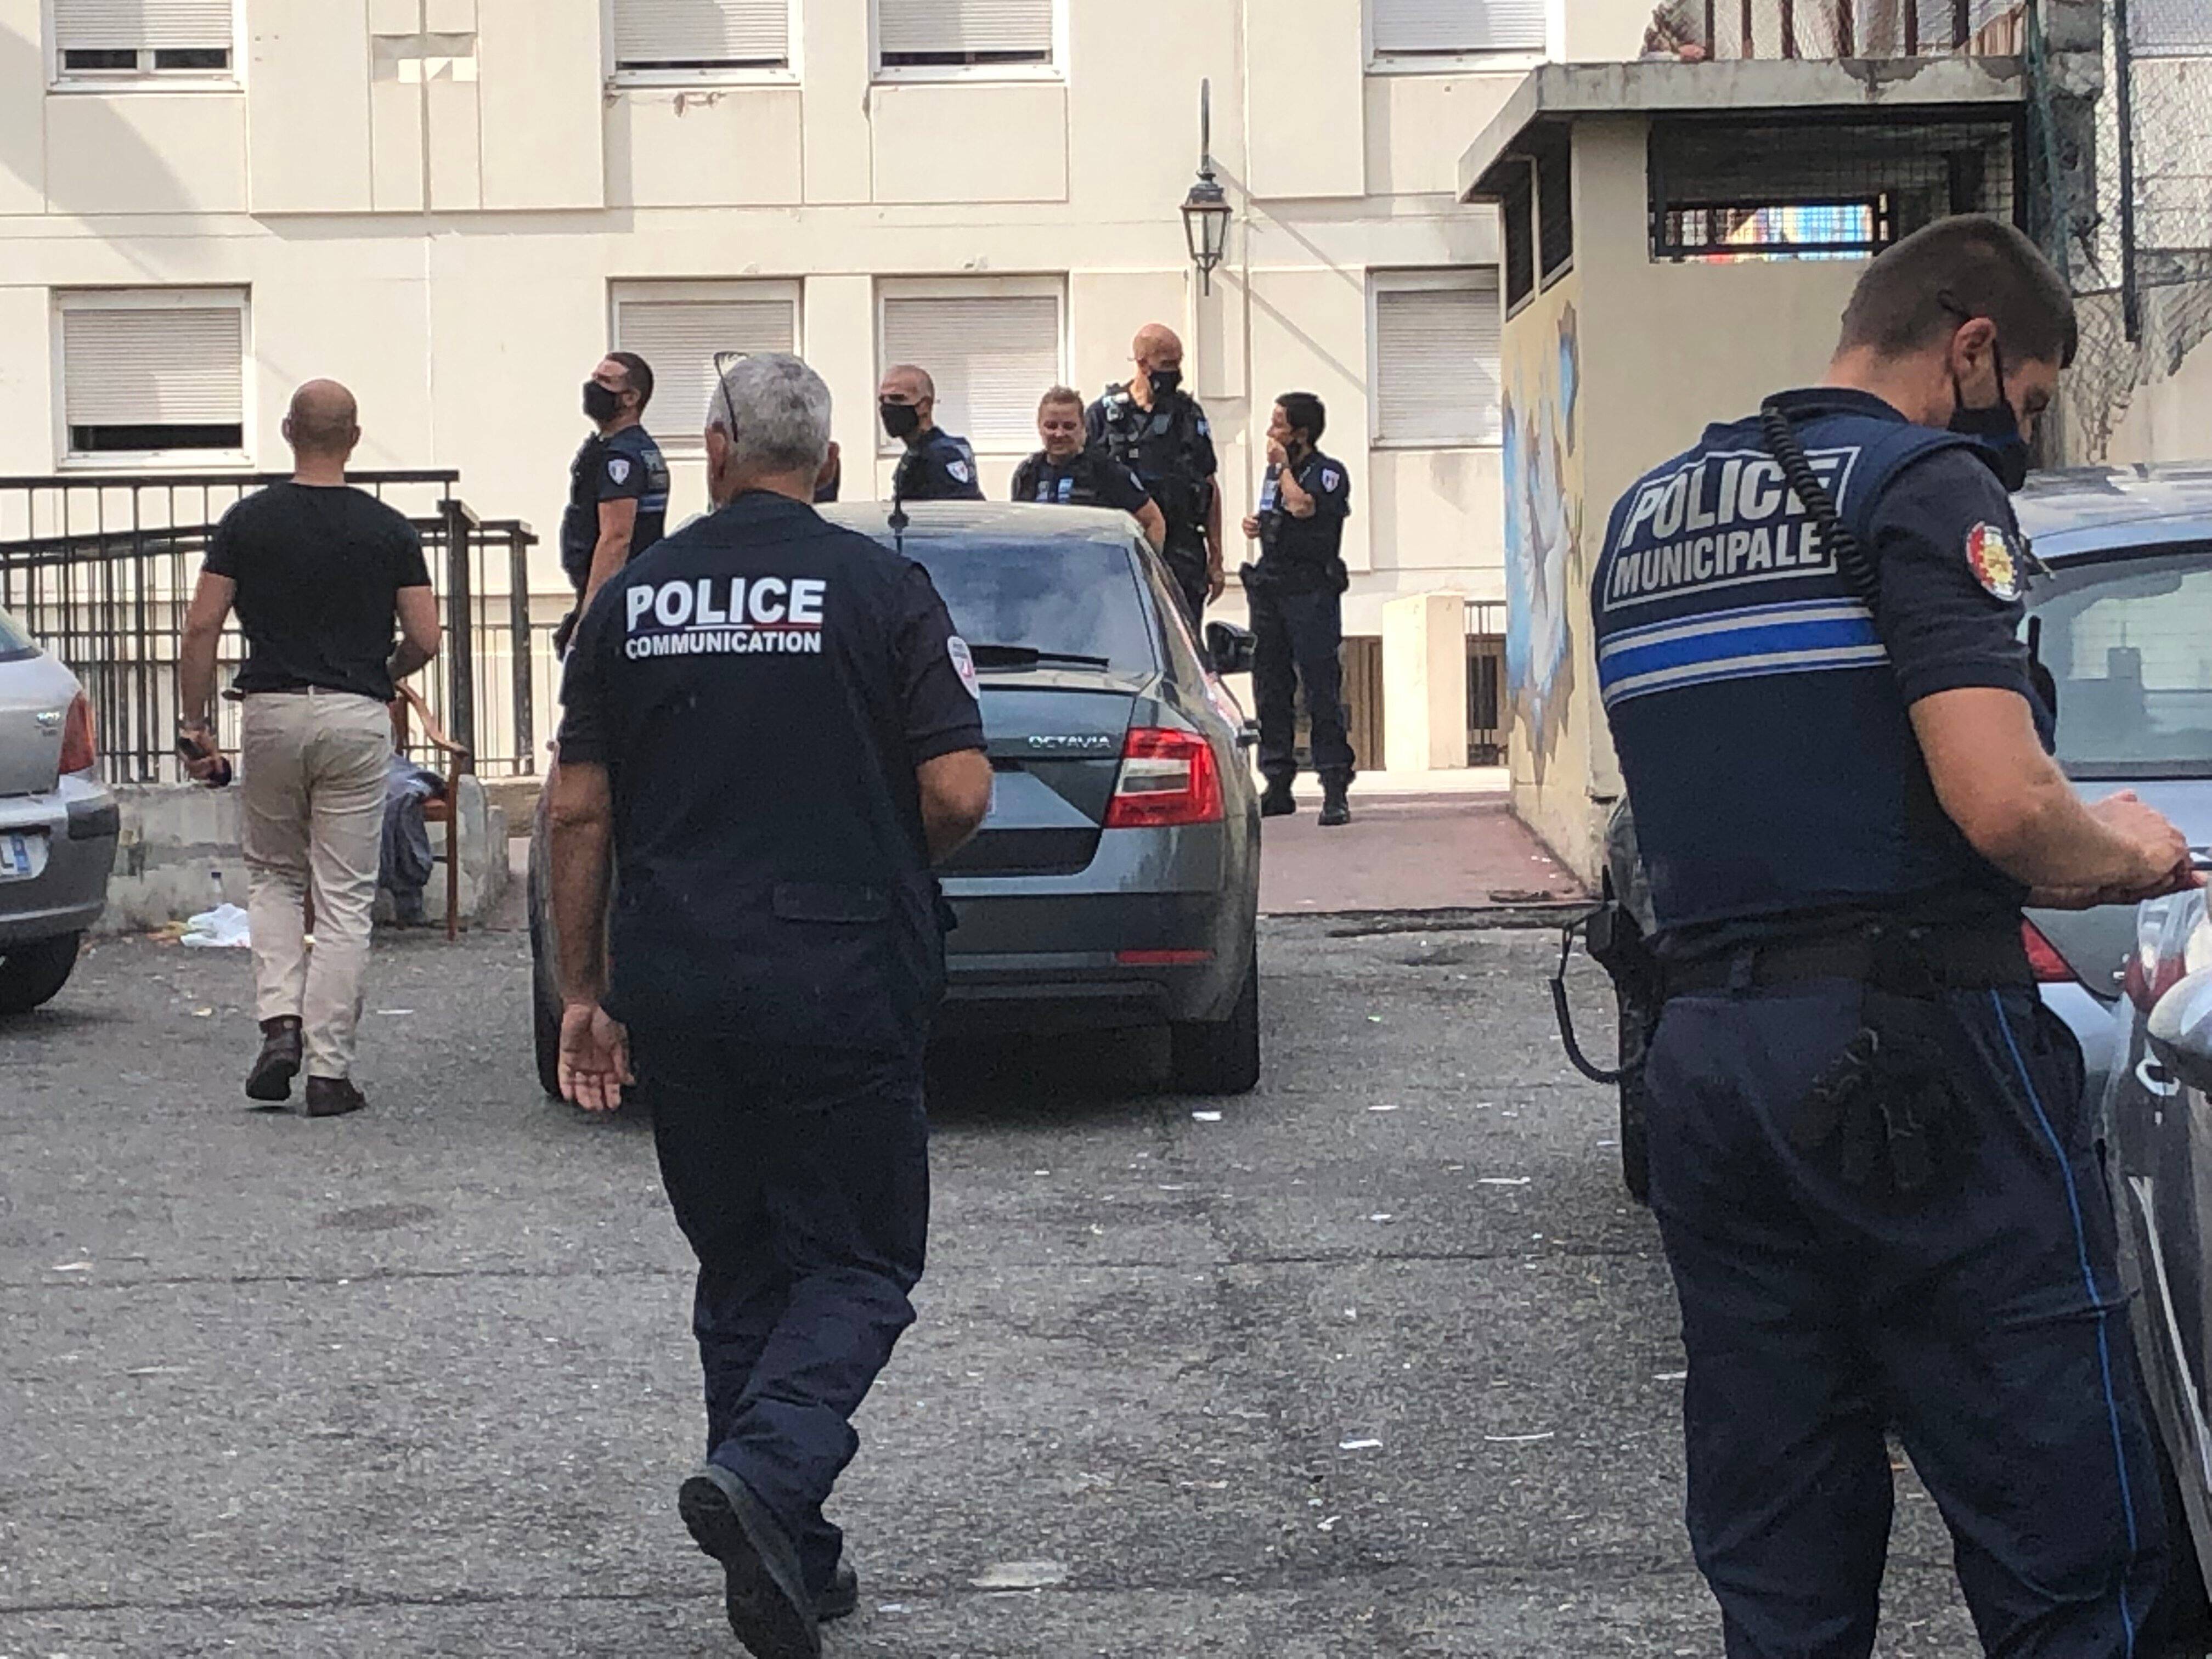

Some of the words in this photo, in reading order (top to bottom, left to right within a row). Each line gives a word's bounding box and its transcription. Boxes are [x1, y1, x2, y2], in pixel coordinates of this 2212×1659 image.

[1612, 522, 1822, 598] MUNICIPALE
[627, 577, 826, 631] POLICE
[625, 631, 821, 659] COMMUNICATION
[1028, 735, 1111, 748] OCTAVIA
